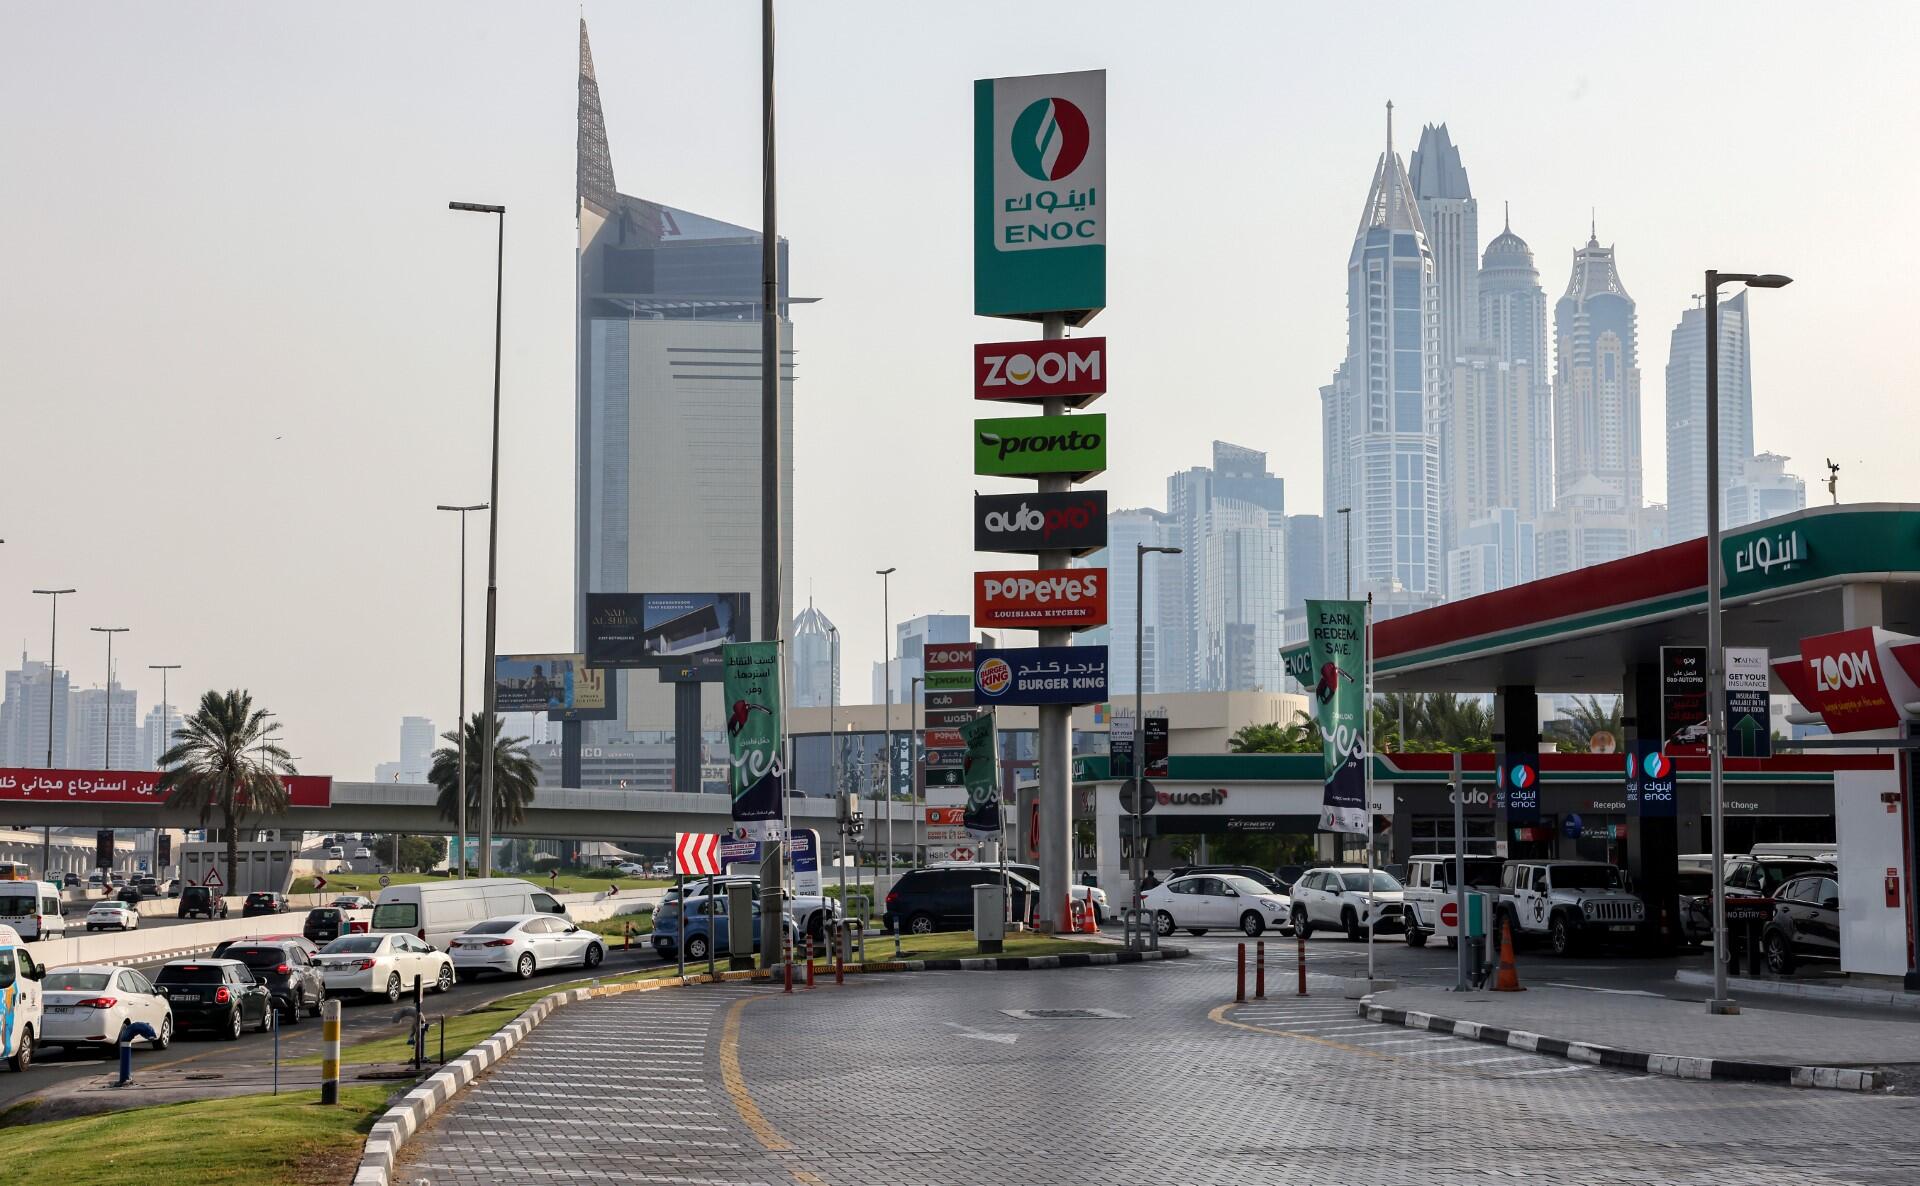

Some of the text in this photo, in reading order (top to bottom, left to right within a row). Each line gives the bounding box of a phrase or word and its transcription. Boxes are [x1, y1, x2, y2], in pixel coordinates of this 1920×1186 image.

[1005, 187, 1096, 214] اينوك
[1005, 219, 1096, 243] ENOC
[982, 350, 1100, 387] ZOOM
[998, 430, 1101, 461] pronto
[1736, 531, 1798, 575] اينوك
[994, 608, 1087, 618] LOUISIANA KITCHEN
[1320, 613, 1352, 626] EARN.
[1314, 627, 1359, 641] REDEEM.
[929, 651, 972, 663] ZOOM
[1285, 652, 1310, 676] ENOC
[980, 665, 1008, 678] BURGER
[1018, 661, 1104, 676] برجر كنج
[1810, 650, 1876, 692] ZOOM
[981, 671, 1010, 688] KING
[1018, 677, 1105, 691] BURGER KING
[21, 776, 63, 795] مجاني
[67, 777, 126, 796] استرجاع
[1643, 781, 1672, 793] اينوك
[1511, 791, 1536, 800] اينوك
[1730, 801, 1759, 811] Change
